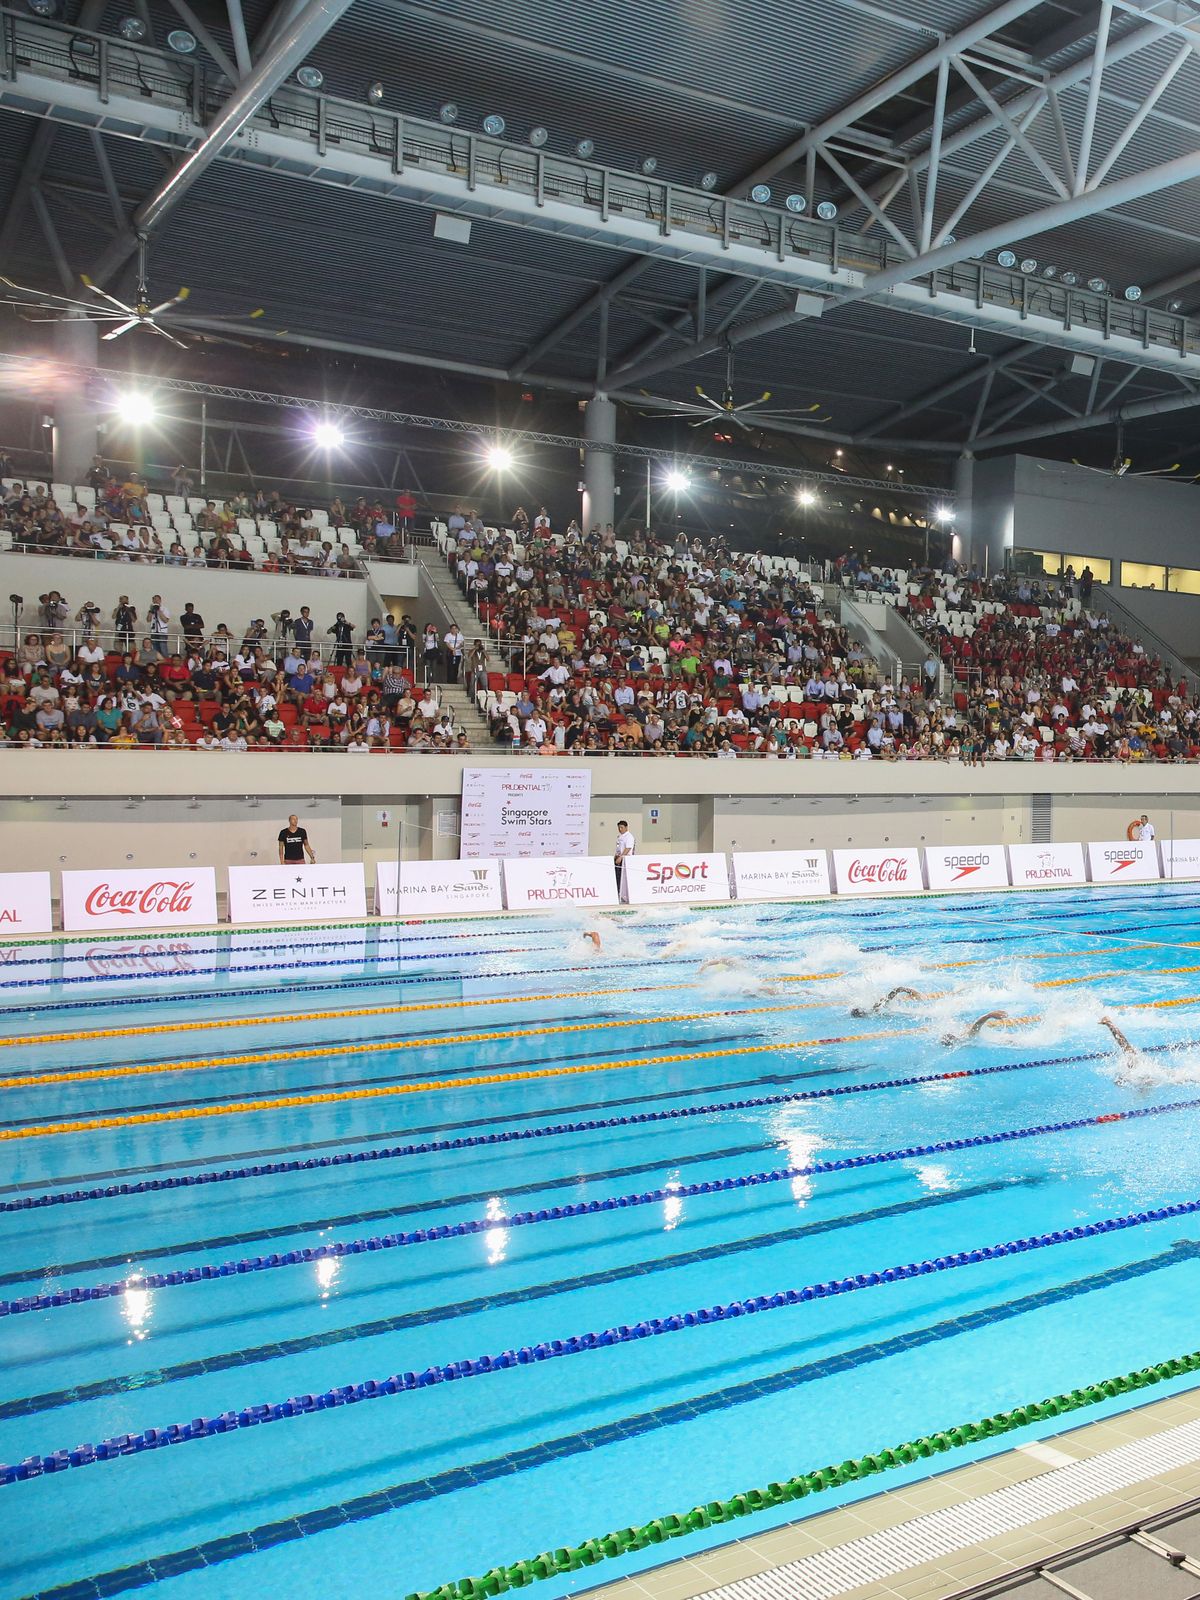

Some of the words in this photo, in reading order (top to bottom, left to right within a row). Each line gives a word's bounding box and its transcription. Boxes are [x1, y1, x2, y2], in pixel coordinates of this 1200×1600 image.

[501, 807, 548, 818] Singapore
[501, 816, 527, 826] Swim
[529, 816, 552, 826] Stars
[943, 852, 990, 869] speedo
[1104, 847, 1143, 862] speedo
[646, 861, 708, 884] Sport
[740, 872, 773, 881] MARINA
[774, 871, 789, 880] BAY
[847, 857, 908, 883] Coca-Cola
[1025, 867, 1073, 879] PRUDENTIAL
[252, 886, 346, 900] ZENITH
[386, 885, 427, 895] MARINA
[431, 885, 449, 893] BAY
[452, 882, 490, 892] Sands
[527, 887, 599, 901] PRUDENTIAL
[651, 884, 707, 894] SINGAPORE
[85, 881, 196, 916] Coca-Cola
